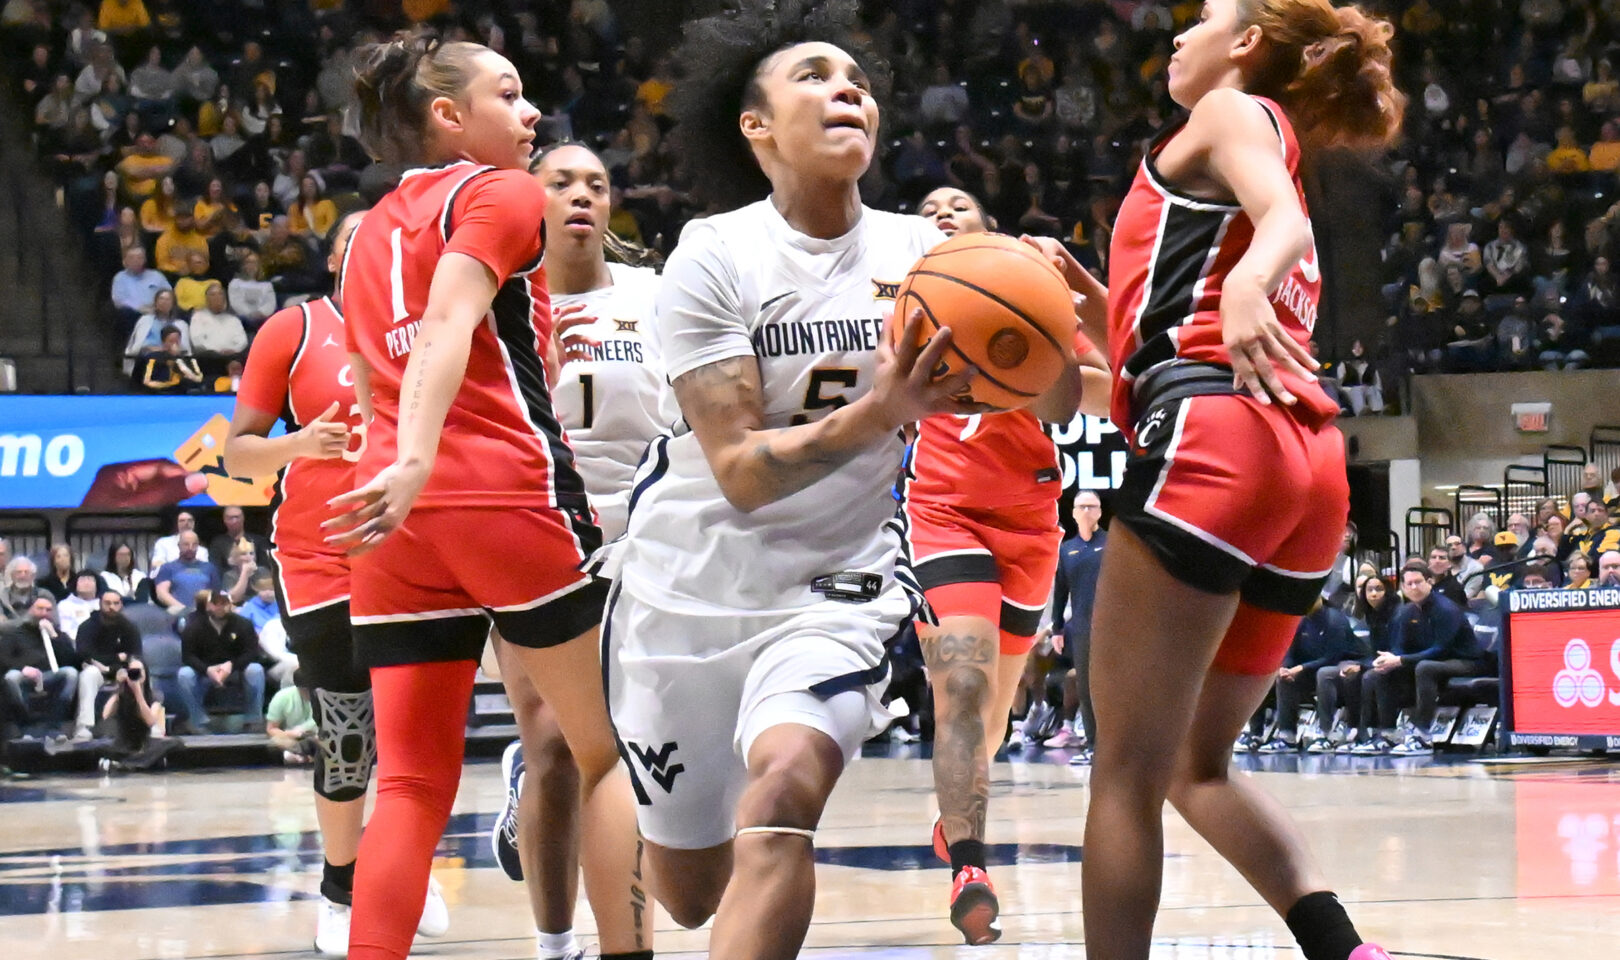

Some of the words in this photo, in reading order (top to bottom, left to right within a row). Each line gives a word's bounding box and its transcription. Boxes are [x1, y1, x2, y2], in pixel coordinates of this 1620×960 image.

[390, 227, 410, 324] 1
[1272, 275, 1318, 333] JACKSO
[578, 372, 594, 429] 1
[1521, 590, 1587, 610] DIVERSIFIED
[1588, 589, 1620, 607] ENER
